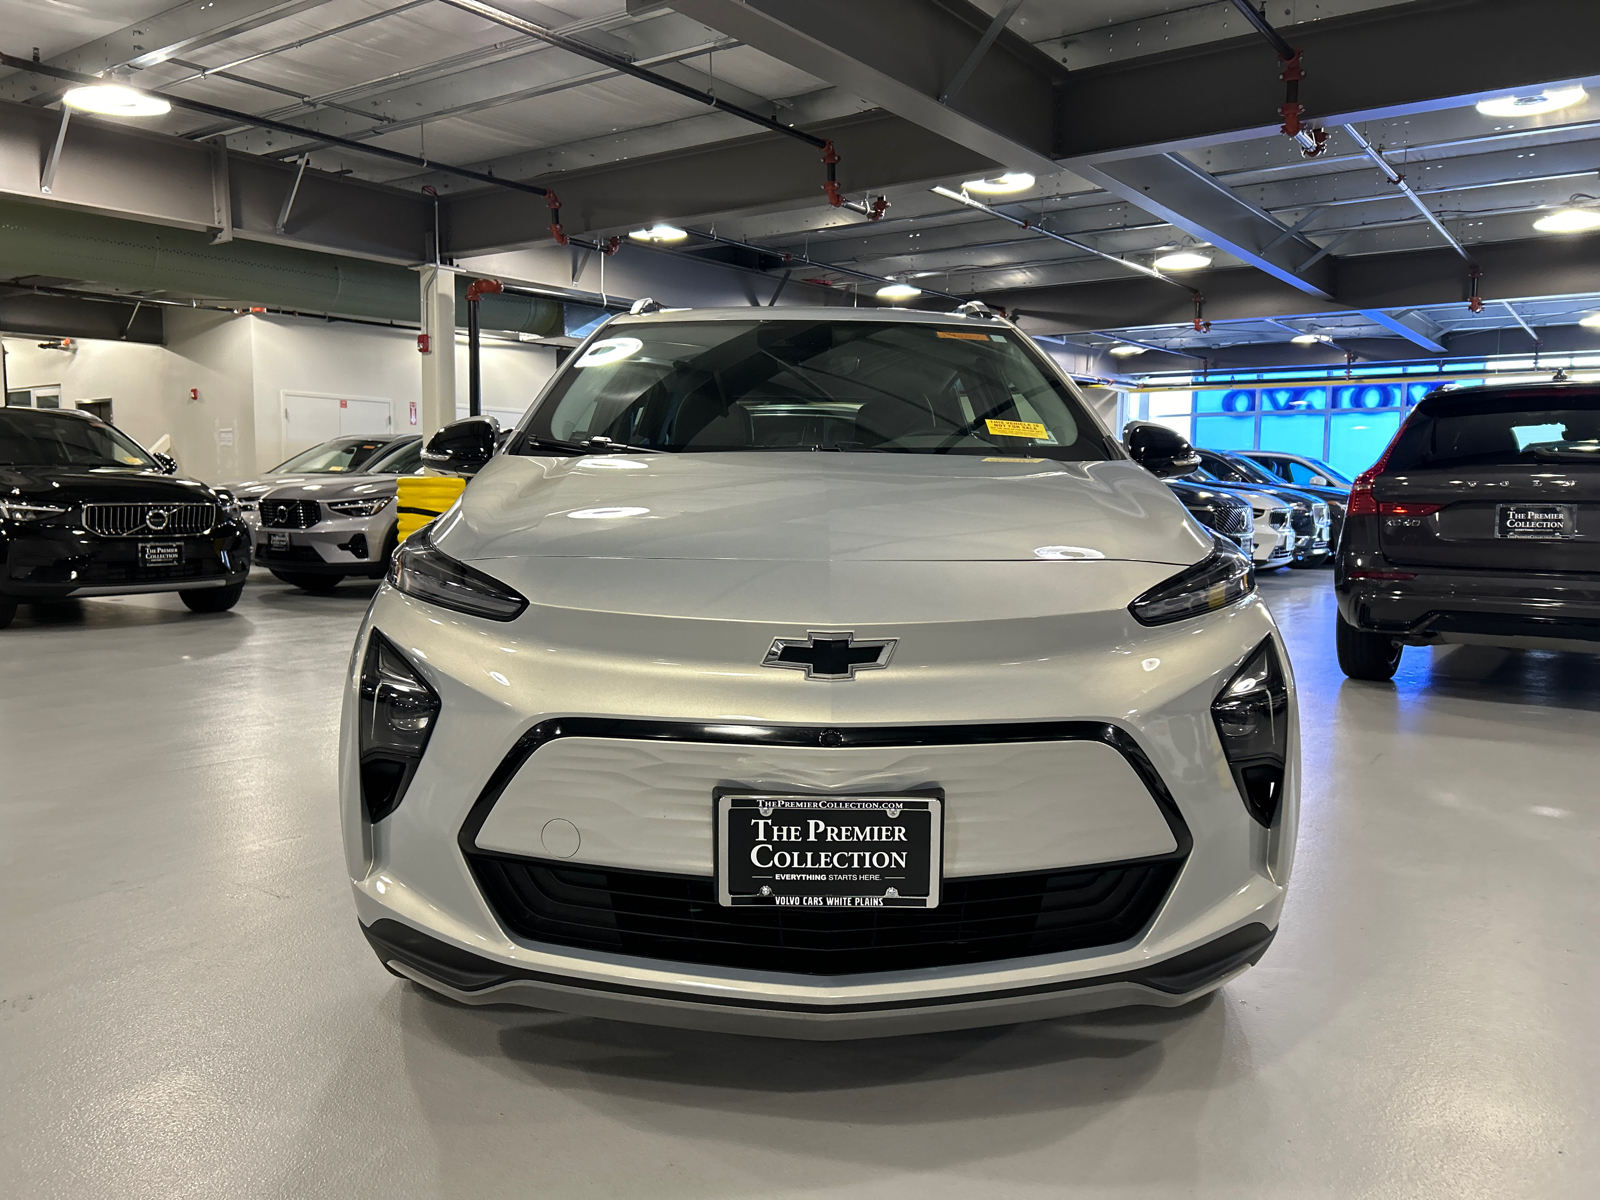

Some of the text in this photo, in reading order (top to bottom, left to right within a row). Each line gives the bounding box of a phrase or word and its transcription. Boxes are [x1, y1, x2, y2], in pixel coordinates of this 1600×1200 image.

[1507, 511, 1564, 519] THE PREMIER
[1506, 519, 1564, 528] COLLECTION
[757, 799, 904, 810] THEPREMIERCOLLECTION.COM
[750, 818, 908, 842] THE PREMIER
[750, 844, 908, 869] COLLECTION
[775, 873, 827, 881] EVERYTHING
[775, 896, 884, 906] VOLVO CARS WHITE PLAINS
